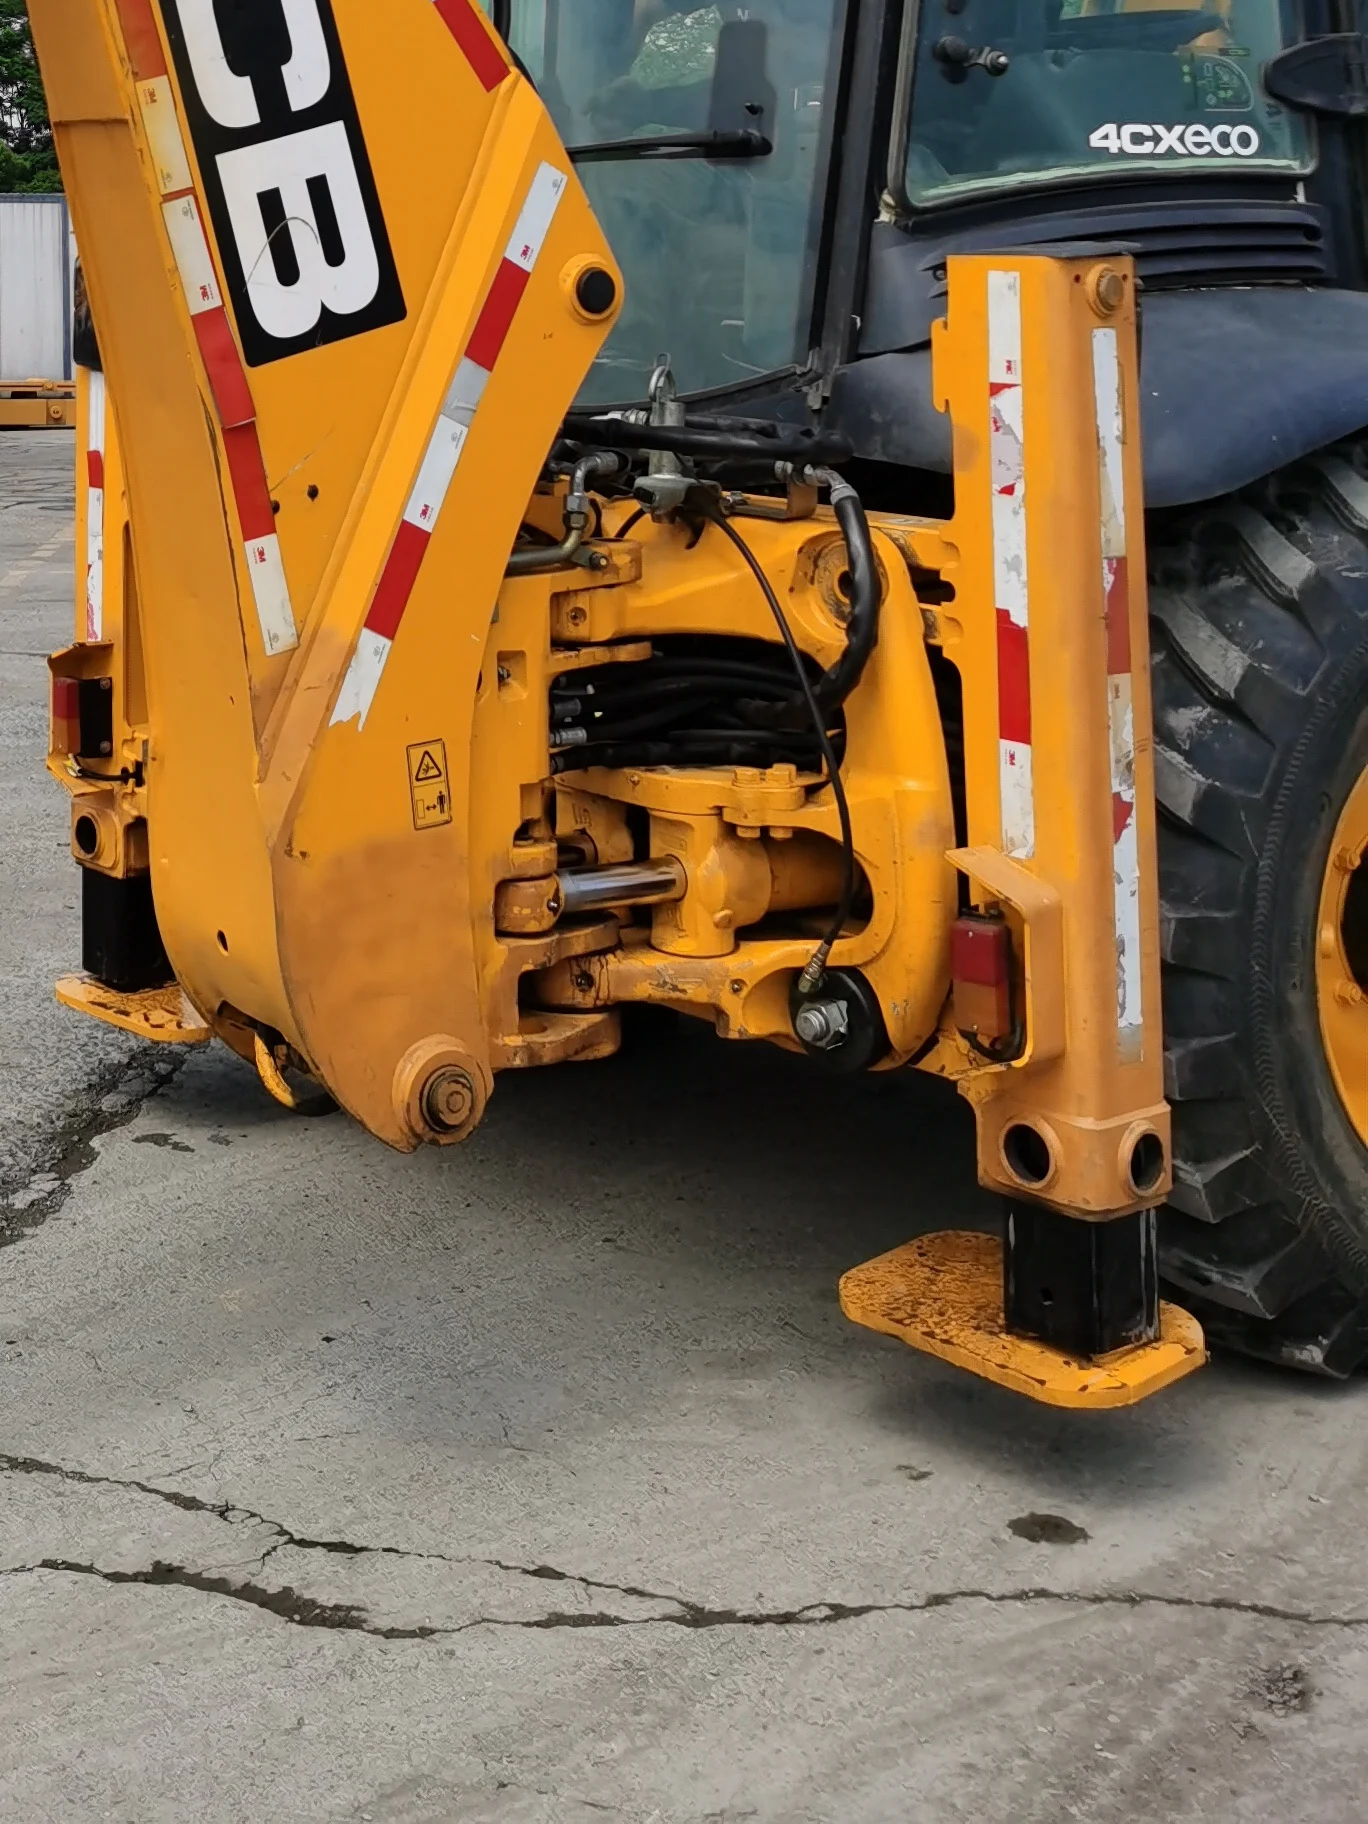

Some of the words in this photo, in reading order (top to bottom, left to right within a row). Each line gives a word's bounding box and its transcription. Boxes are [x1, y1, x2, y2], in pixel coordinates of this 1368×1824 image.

[148, 88, 157, 104] 3M
[1089, 123, 1259, 156] 4CXeco
[520, 244, 531, 260] 3M
[200, 285, 209, 301] 3M
[420, 504, 430, 519] 3M
[257, 546, 266, 563] 3M
